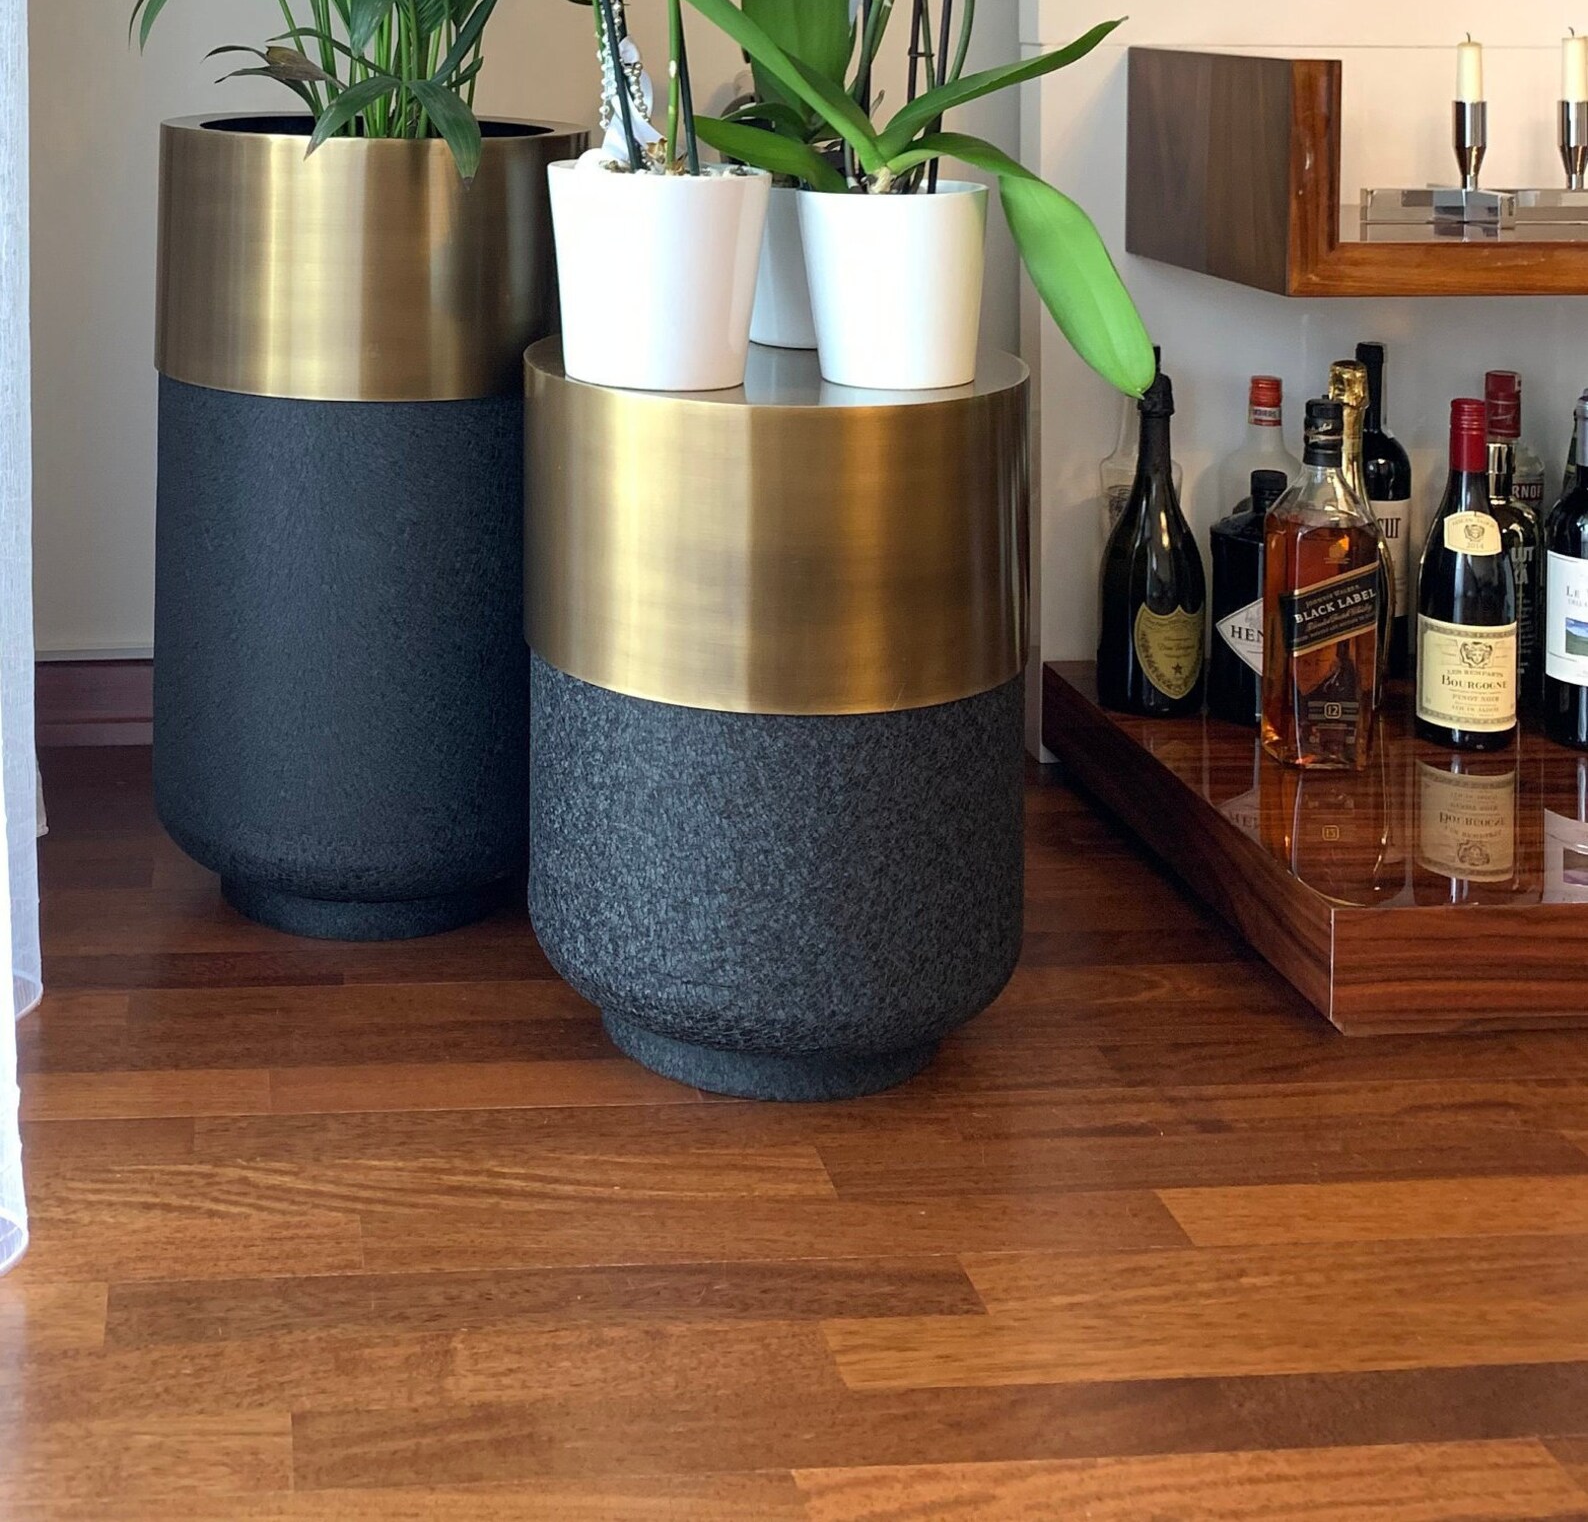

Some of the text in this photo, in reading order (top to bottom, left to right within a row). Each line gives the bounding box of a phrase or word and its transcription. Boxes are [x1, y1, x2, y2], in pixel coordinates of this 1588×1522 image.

[1294, 588, 1376, 624] BLACK LABEL
[1327, 705, 1338, 716] 12
